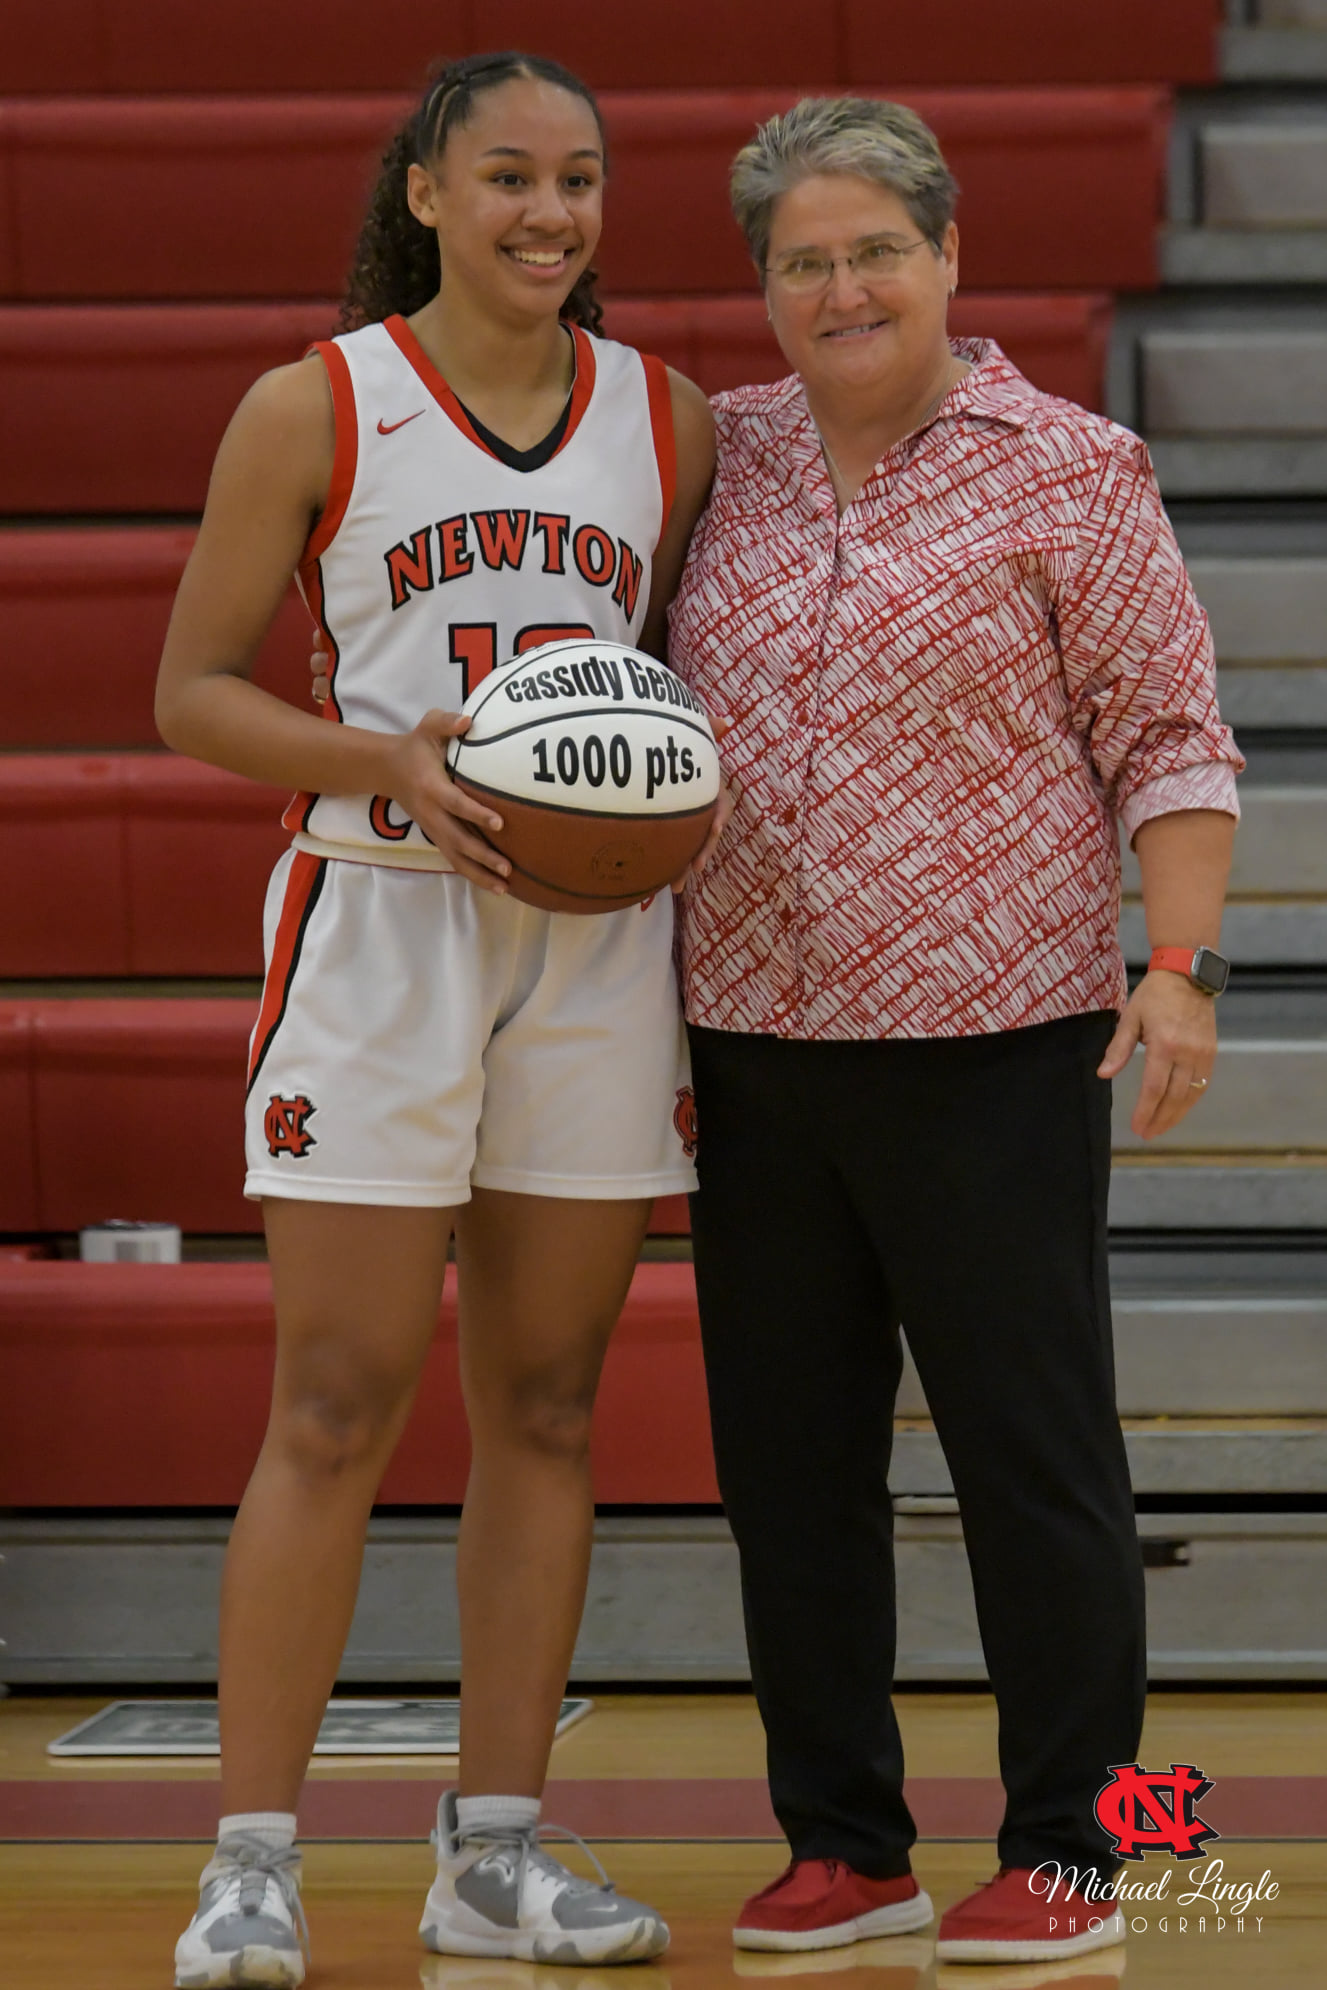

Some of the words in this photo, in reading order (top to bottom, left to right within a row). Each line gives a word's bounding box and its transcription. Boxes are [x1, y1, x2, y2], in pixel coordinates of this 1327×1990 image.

[384, 509, 643, 625] NEWTON
[532, 733, 632, 788] 1000
[645, 735, 701, 799] pts.
